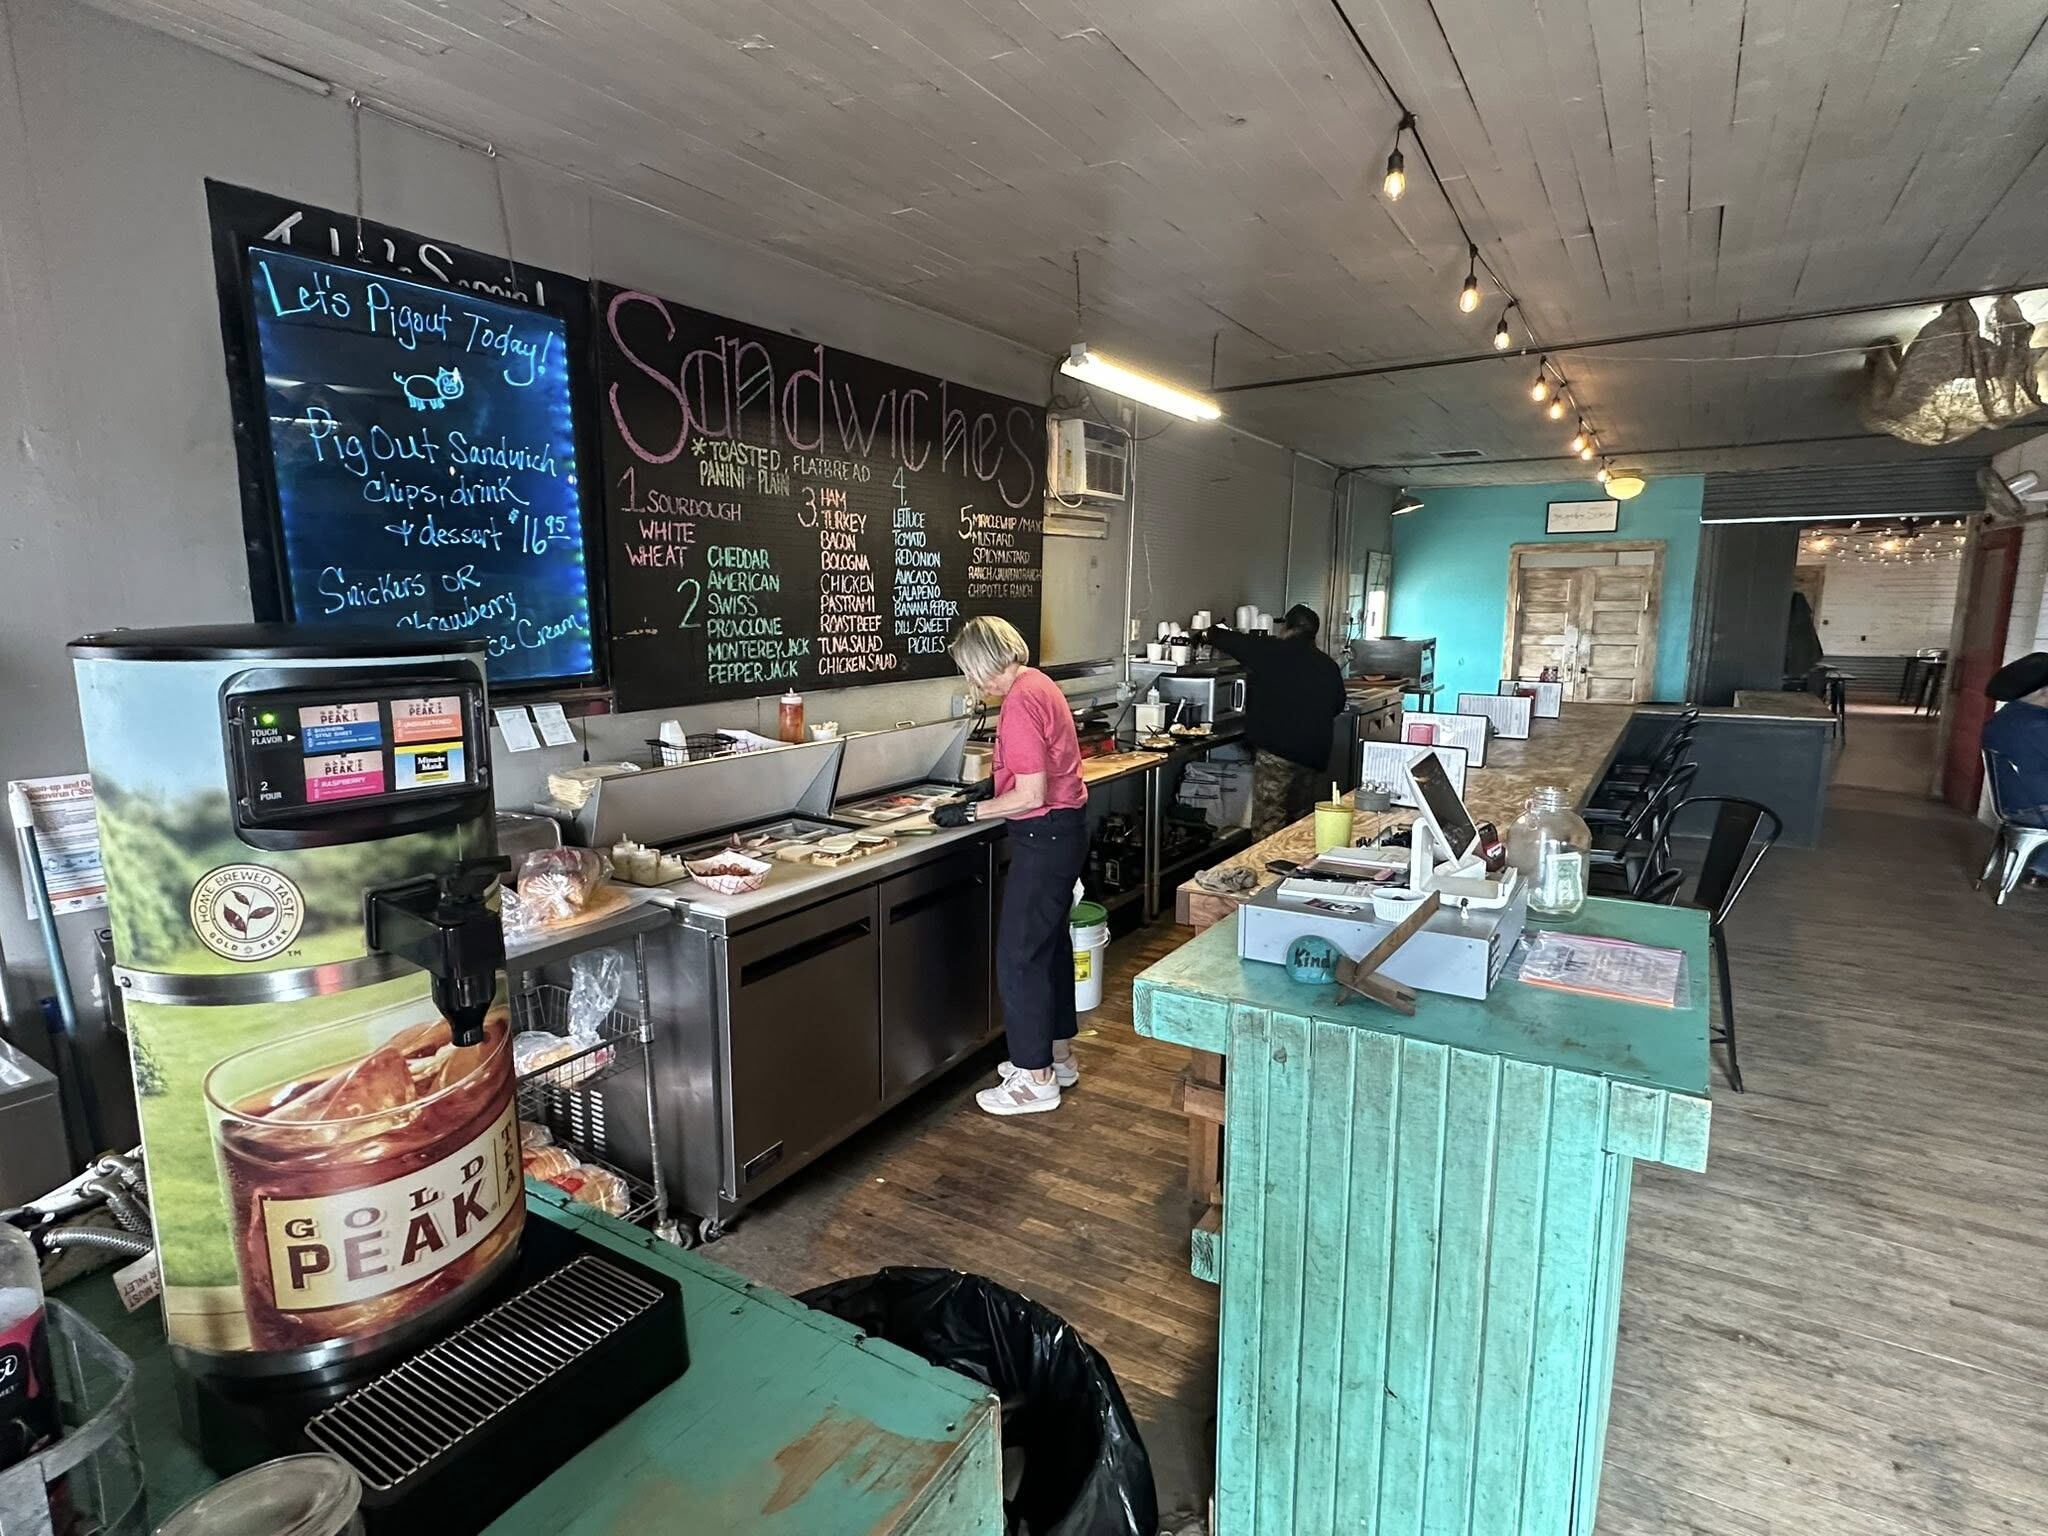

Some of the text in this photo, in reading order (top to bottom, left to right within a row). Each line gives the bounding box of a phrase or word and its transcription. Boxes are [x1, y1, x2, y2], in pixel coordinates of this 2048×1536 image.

[259, 261, 351, 317] Let's
[366, 283, 452, 350] Pigout
[464, 311, 554, 386] Today!
[606, 290, 1035, 509] Sandwiches
[306, 406, 557, 477] Pig Out Sandwich
[700, 459, 745, 490] PANINI
[793, 455, 871, 483] FLATBREAD
[646, 488, 742, 522] SOURDOUGH
[820, 487, 847, 512] HAM
[820, 510, 867, 535] TURKEY
[893, 507, 926, 528] LETTUCE
[418, 514, 503, 551] dessert
[638, 519, 697, 544] WHITE
[820, 530, 857, 552] BACON
[892, 529, 927, 548] TOMATO
[972, 530, 1016, 548] MUSTARD
[624, 542, 689, 568] WHEAT
[707, 545, 771, 570] CHEDDAR
[821, 550, 871, 571] BOLOGNA
[820, 572, 875, 595] CHICKEN
[892, 585, 941, 603] JALAPENO
[677, 569, 781, 629] 2 AMERICAN
[708, 592, 759, 616] SWISS
[820, 594, 876, 614] PASTRAMI
[517, 614, 584, 649] Cream
[707, 617, 784, 638] PROVOLONE
[908, 635, 946, 654] PICKLES
[708, 660, 799, 684] PEPPER JACK
[320, 714, 350, 724] PEAK
[409, 707, 434, 716] PEAK
[251, 728, 278, 737] TOUCH
[252, 735, 283, 746] FLAVOR
[325, 766, 354, 776] PEAK
[260, 781, 269, 791] 2
[260, 792, 282, 801] POUR
[198, 871, 296, 924] HOME BREWED TASTE
[208, 928, 289, 952] GOLD PEAK
[1294, 948, 1331, 969] Kind
[284, 1155, 485, 1239] GOLD
[286, 1178, 490, 1290] PEAK
